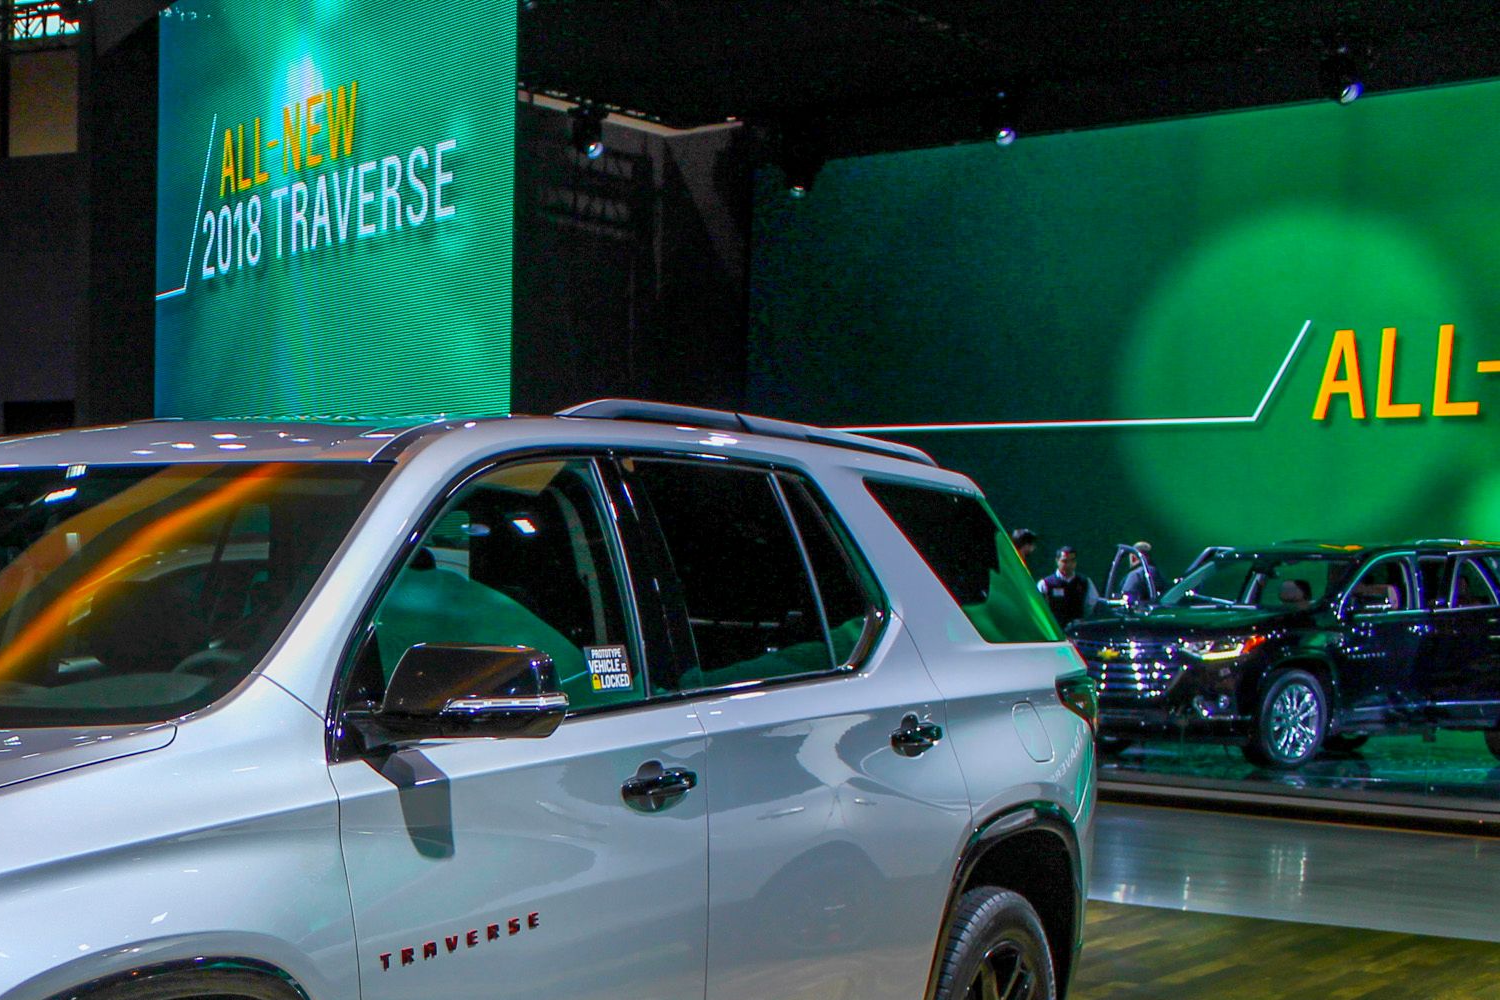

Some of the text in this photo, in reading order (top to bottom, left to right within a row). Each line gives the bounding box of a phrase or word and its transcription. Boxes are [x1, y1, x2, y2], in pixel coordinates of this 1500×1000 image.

[219, 81, 358, 198] ALL-NEW
[202, 194, 262, 280] 2018
[271, 138, 457, 259] TRAVERSE
[1312, 324, 1500, 420] ALL-
[588, 659, 620, 674] VEHICLE
[601, 673, 630, 689] LOCKED
[380, 912, 540, 971] TRAVERSE
